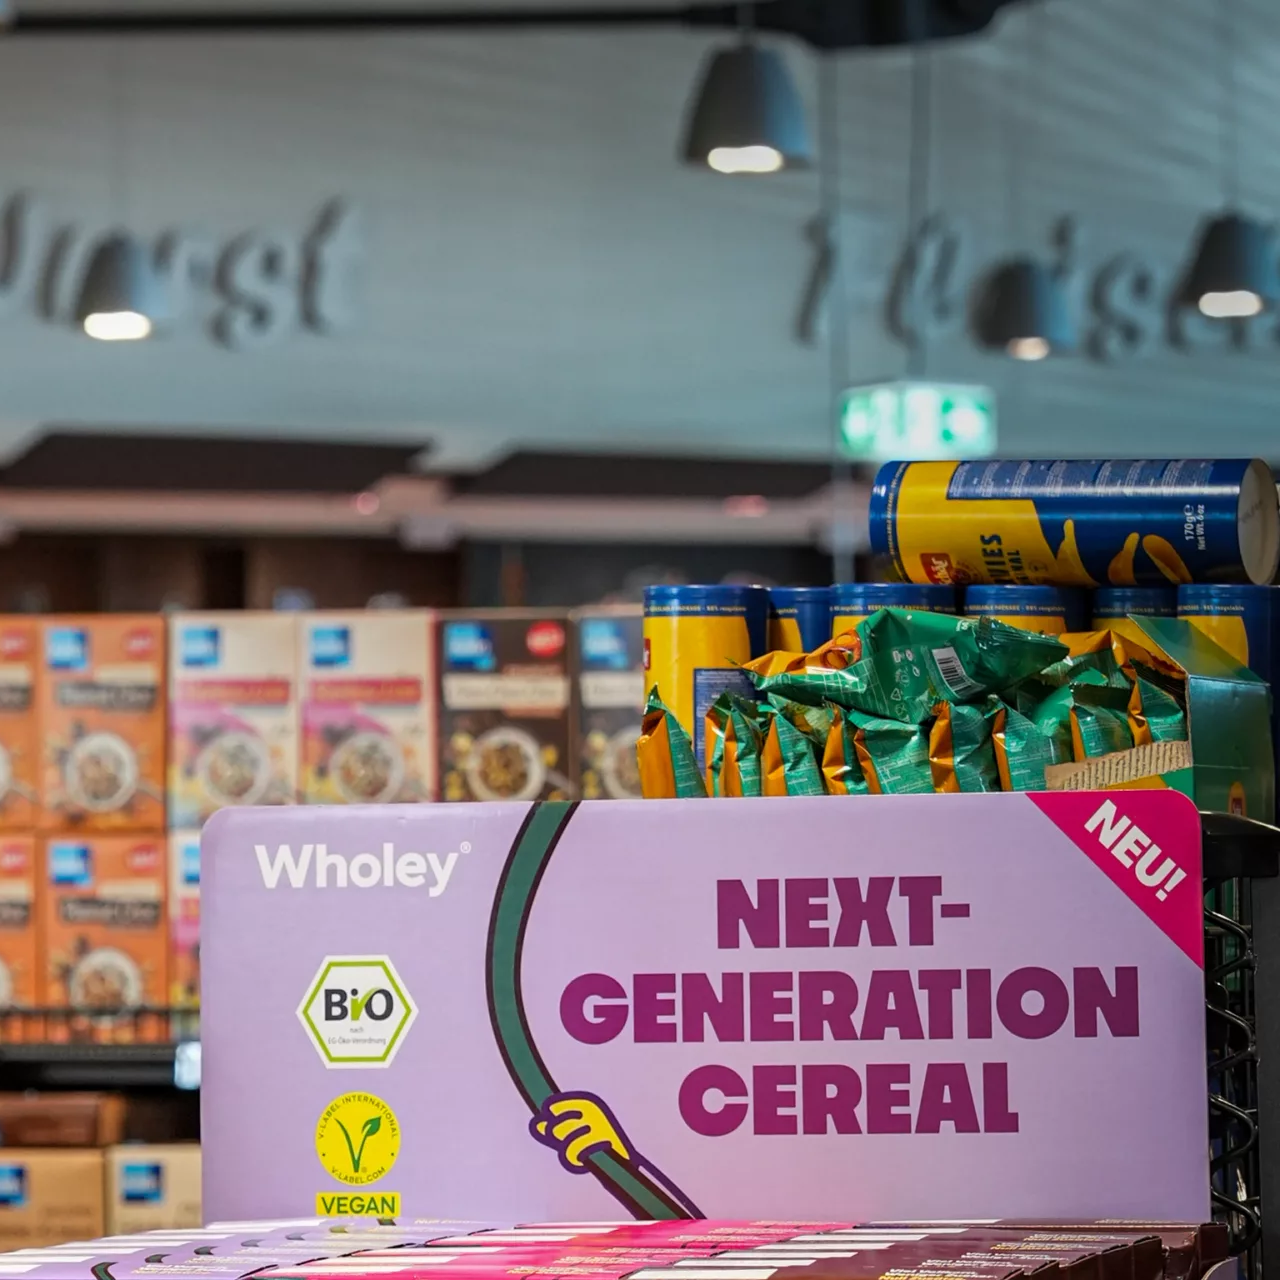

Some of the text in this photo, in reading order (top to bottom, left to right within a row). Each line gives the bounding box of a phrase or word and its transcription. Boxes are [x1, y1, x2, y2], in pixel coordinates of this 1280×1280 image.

[1083, 799, 1188, 902] NEU!
[717, 876, 970, 949] NEXT-
[559, 966, 1140, 1045] GENERATION
[342, 1095, 398, 1138] INTERNATIONAL
[679, 1062, 1019, 1137] CEREAL
[321, 1196, 395, 1214] VEGAN
